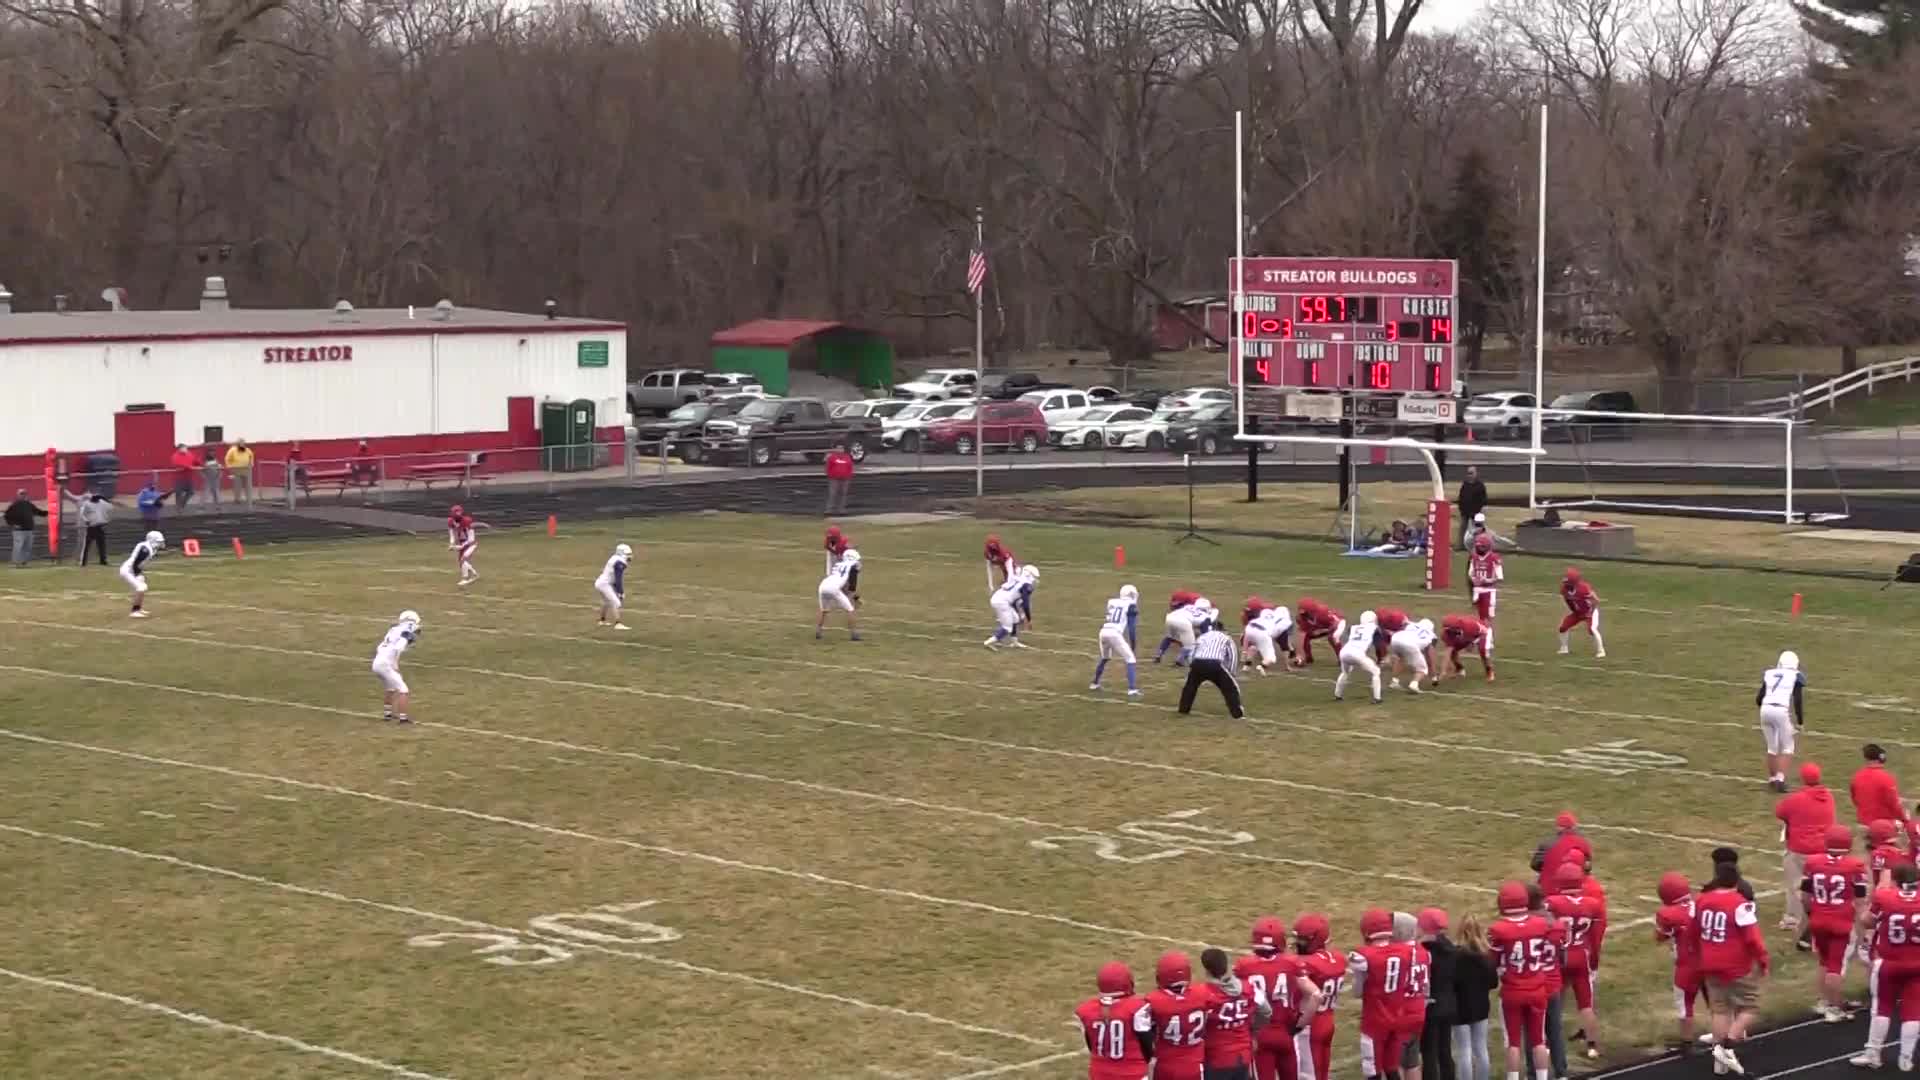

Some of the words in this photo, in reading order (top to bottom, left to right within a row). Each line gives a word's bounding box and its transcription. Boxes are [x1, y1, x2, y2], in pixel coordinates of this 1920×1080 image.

[1263, 270, 1336, 283] STREATOR
[1341, 271, 1417, 284] BULLDOGS
[1234, 296, 1277, 312] LLDOGS
[1403, 298, 1449, 316] GUESTS
[1386, 320, 1397, 341] 3
[1432, 319, 1450, 342] 14
[264, 345, 353, 363] STREATOR
[1240, 342, 1259, 357] ALL
[1296, 343, 1325, 359] DOWN
[1424, 347, 1443, 363] QTR
[1256, 360, 1269, 382] 4
[1312, 362, 1317, 384] 1
[1371, 362, 1390, 388] 10
[1434, 366, 1440, 388] 1
[1403, 403, 1438, 415] Midland
[1771, 673, 1784, 693] 7
[1030, 821, 1256, 863] 20
[1701, 909, 1728, 943] 99
[407, 911, 683, 966] 30
[1509, 938, 1543, 974] 45
[1163, 1010, 1204, 1046] 42
[1092, 1020, 1124, 1060] 78
